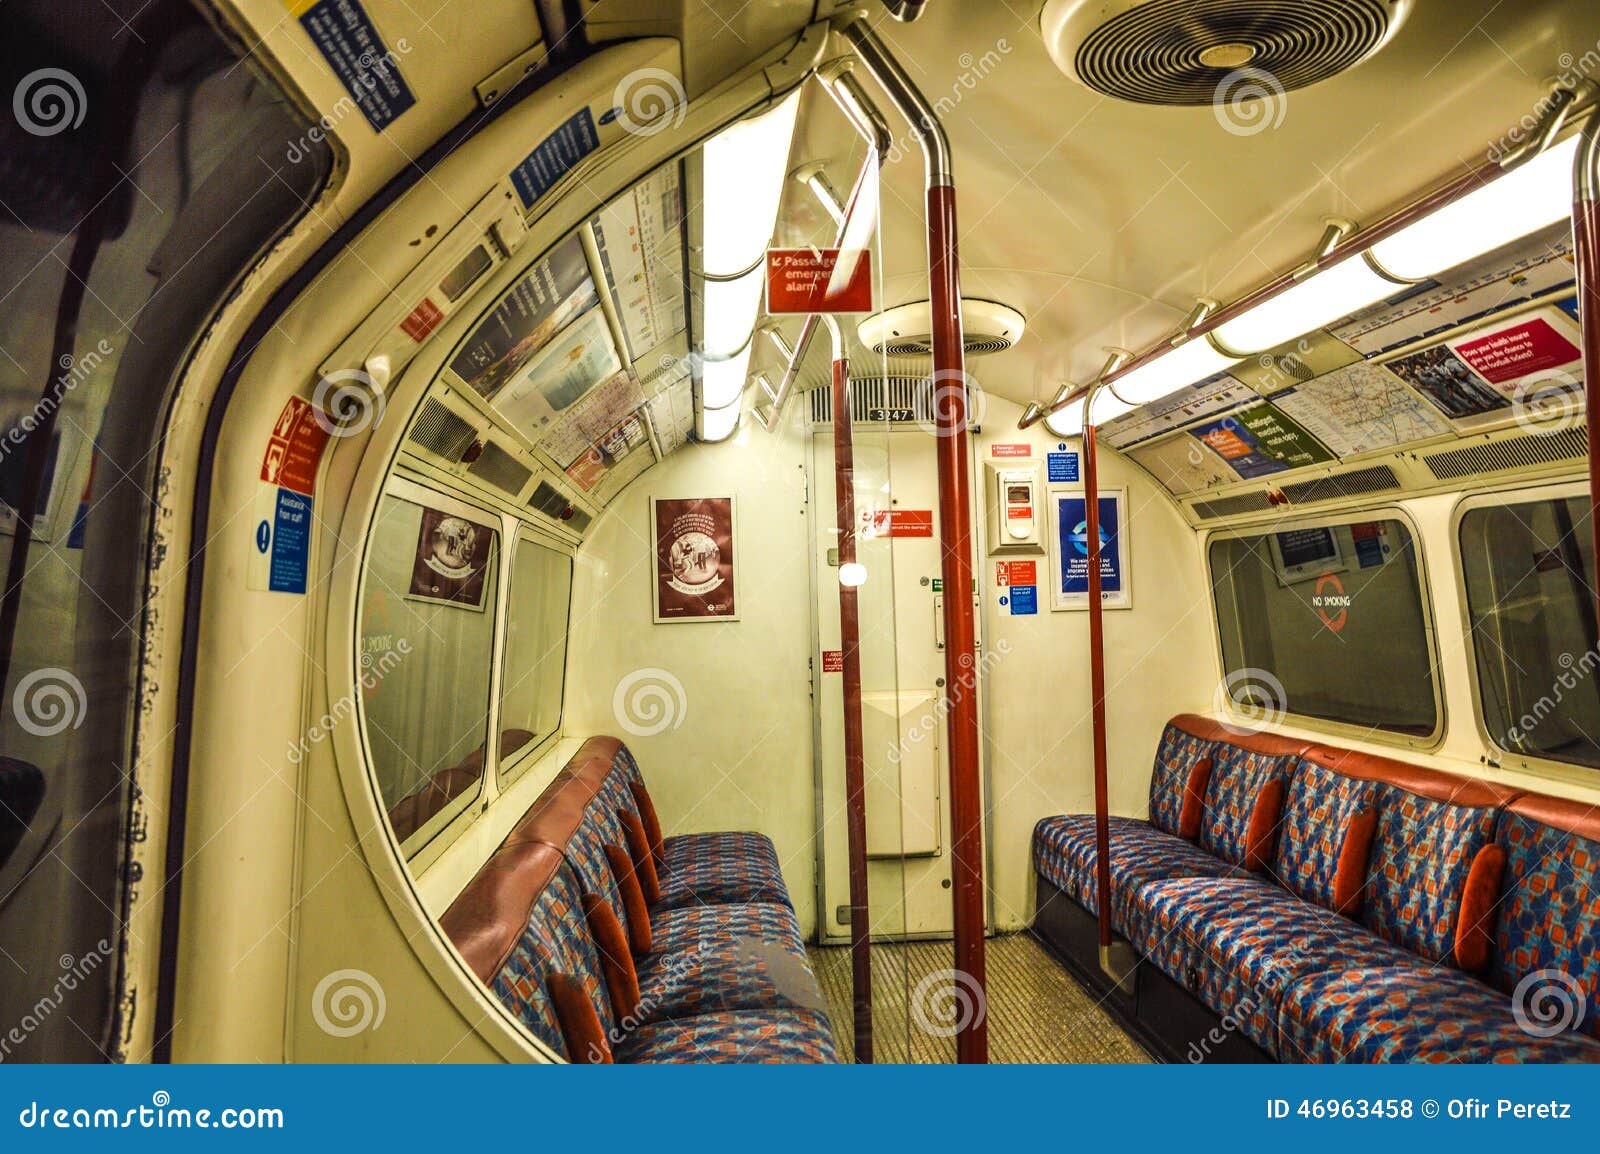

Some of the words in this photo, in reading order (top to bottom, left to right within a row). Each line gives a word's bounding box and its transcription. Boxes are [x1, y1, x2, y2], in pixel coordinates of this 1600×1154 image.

[784, 256, 836, 268] Passenge
[786, 270, 832, 280] emergen
[786, 282, 818, 292] alarm
[1478, 344, 1490, 354] your
[877, 410, 908, 420] 3247
[1312, 596, 1322, 606] NO
[1324, 595, 1350, 606] SMOKING
